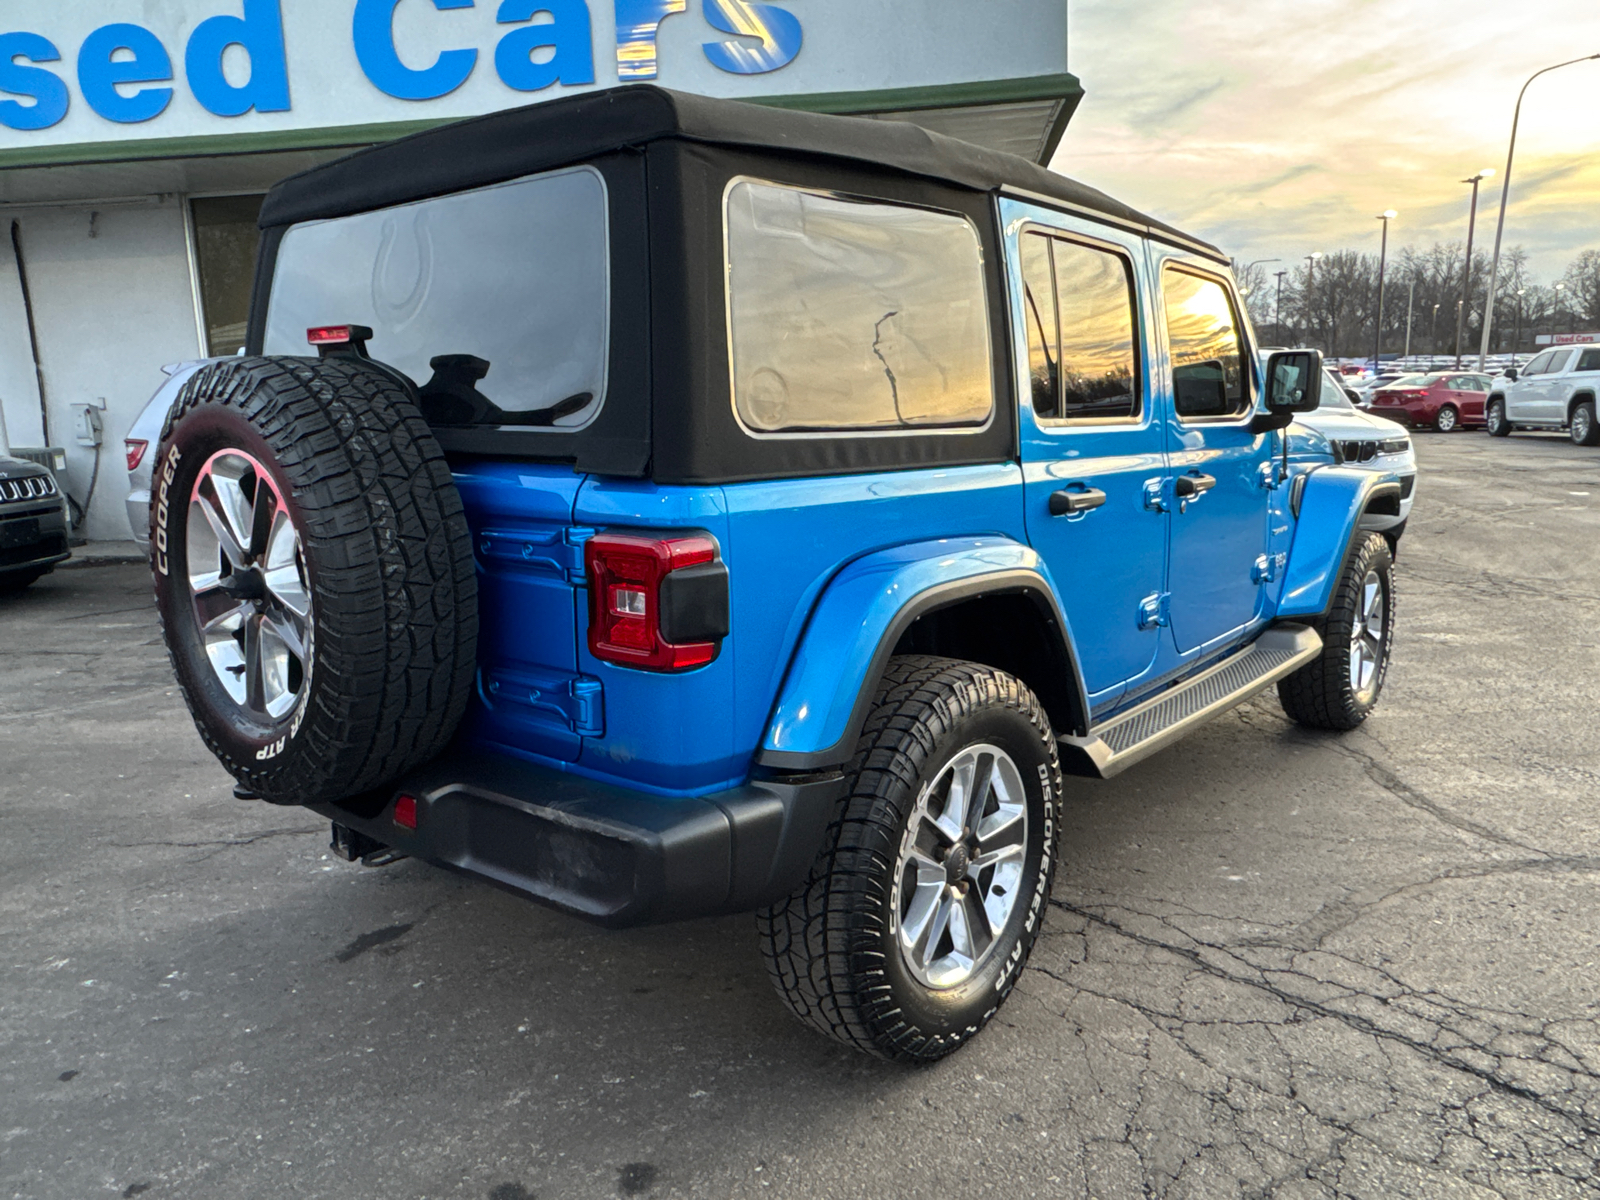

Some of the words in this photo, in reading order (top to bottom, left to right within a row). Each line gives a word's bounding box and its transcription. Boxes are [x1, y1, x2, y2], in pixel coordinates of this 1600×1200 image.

[353, 0, 804, 101] Cars
[1555, 334, 1574, 343] Used
[1576, 334, 1594, 342] Cars
[156, 443, 182, 576] COOPER
[256, 735, 286, 760] ATP
[1024, 762, 1054, 934] DISCOVERER
[995, 939, 1022, 991] ATP
